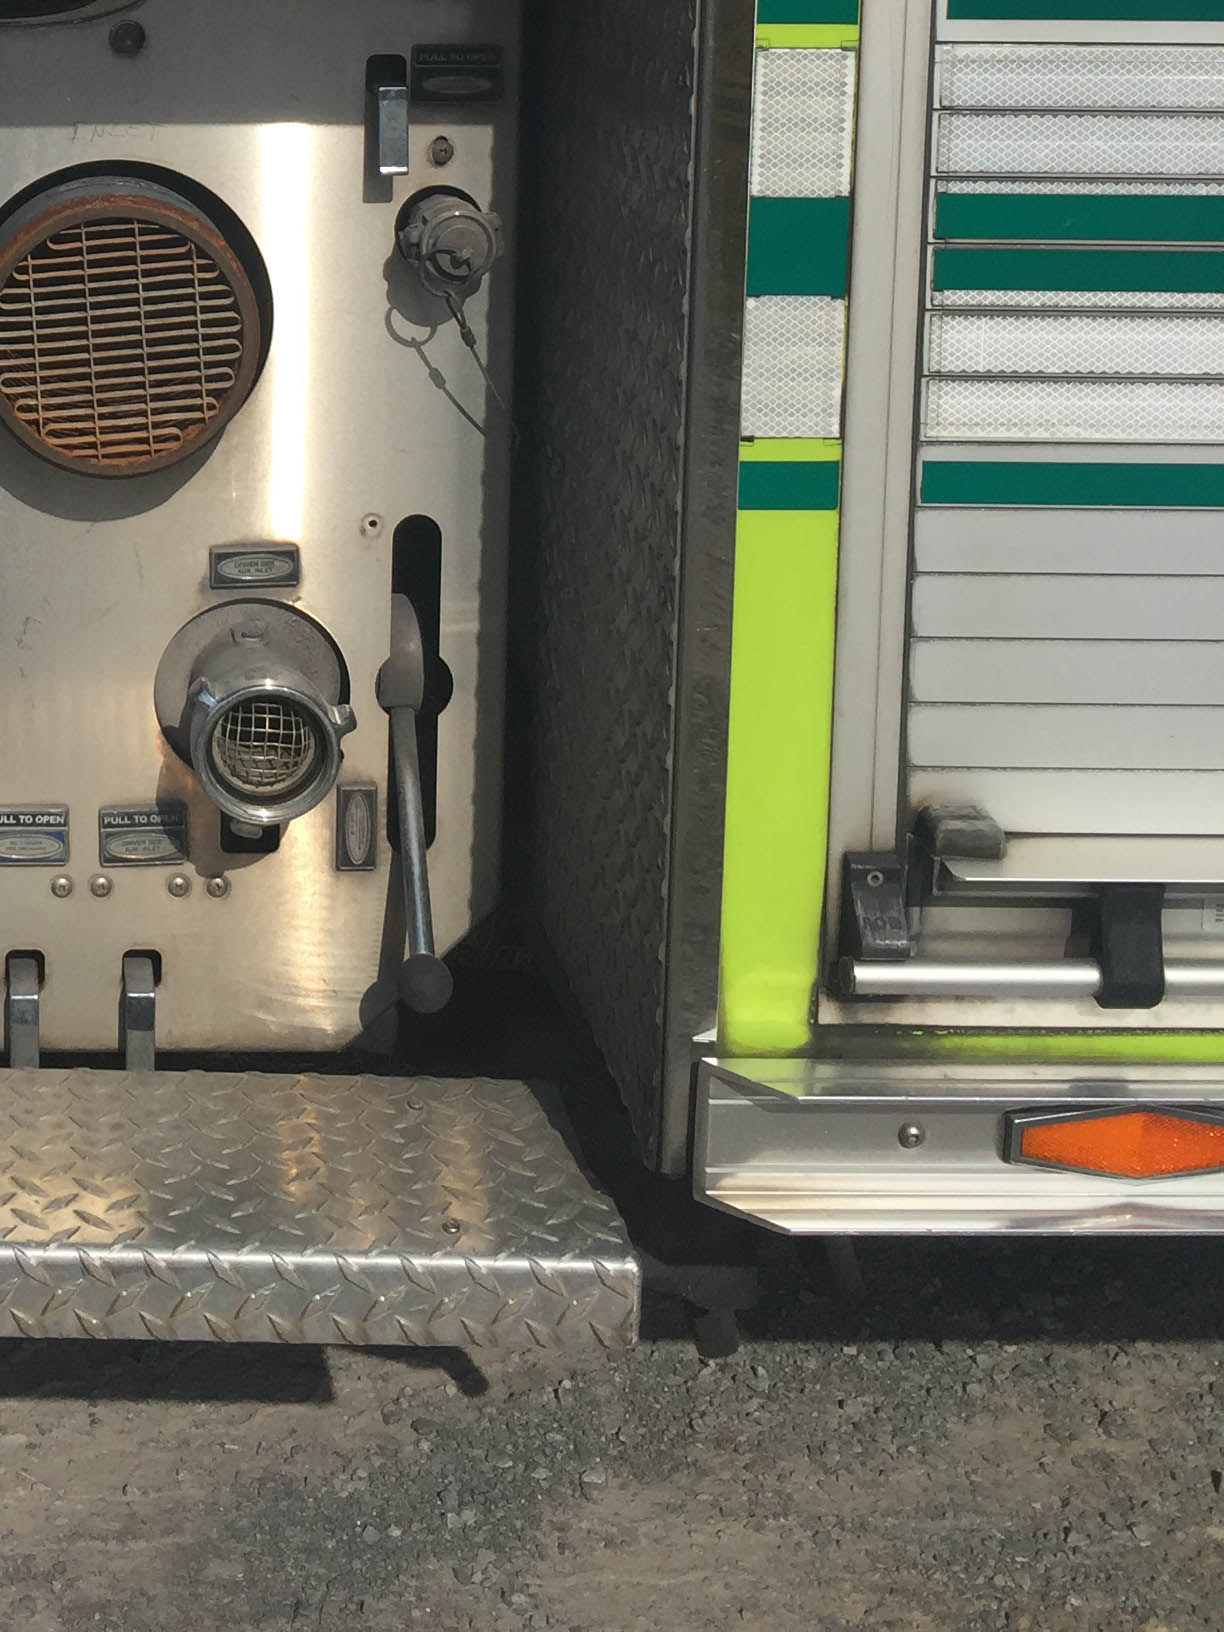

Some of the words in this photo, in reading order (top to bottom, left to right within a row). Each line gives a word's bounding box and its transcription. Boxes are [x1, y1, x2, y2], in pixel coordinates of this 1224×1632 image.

[18, 814, 33, 824] TO
[35, 814, 65, 824] OPEN
[103, 815, 131, 825] PULL
[133, 815, 148, 824] TO
